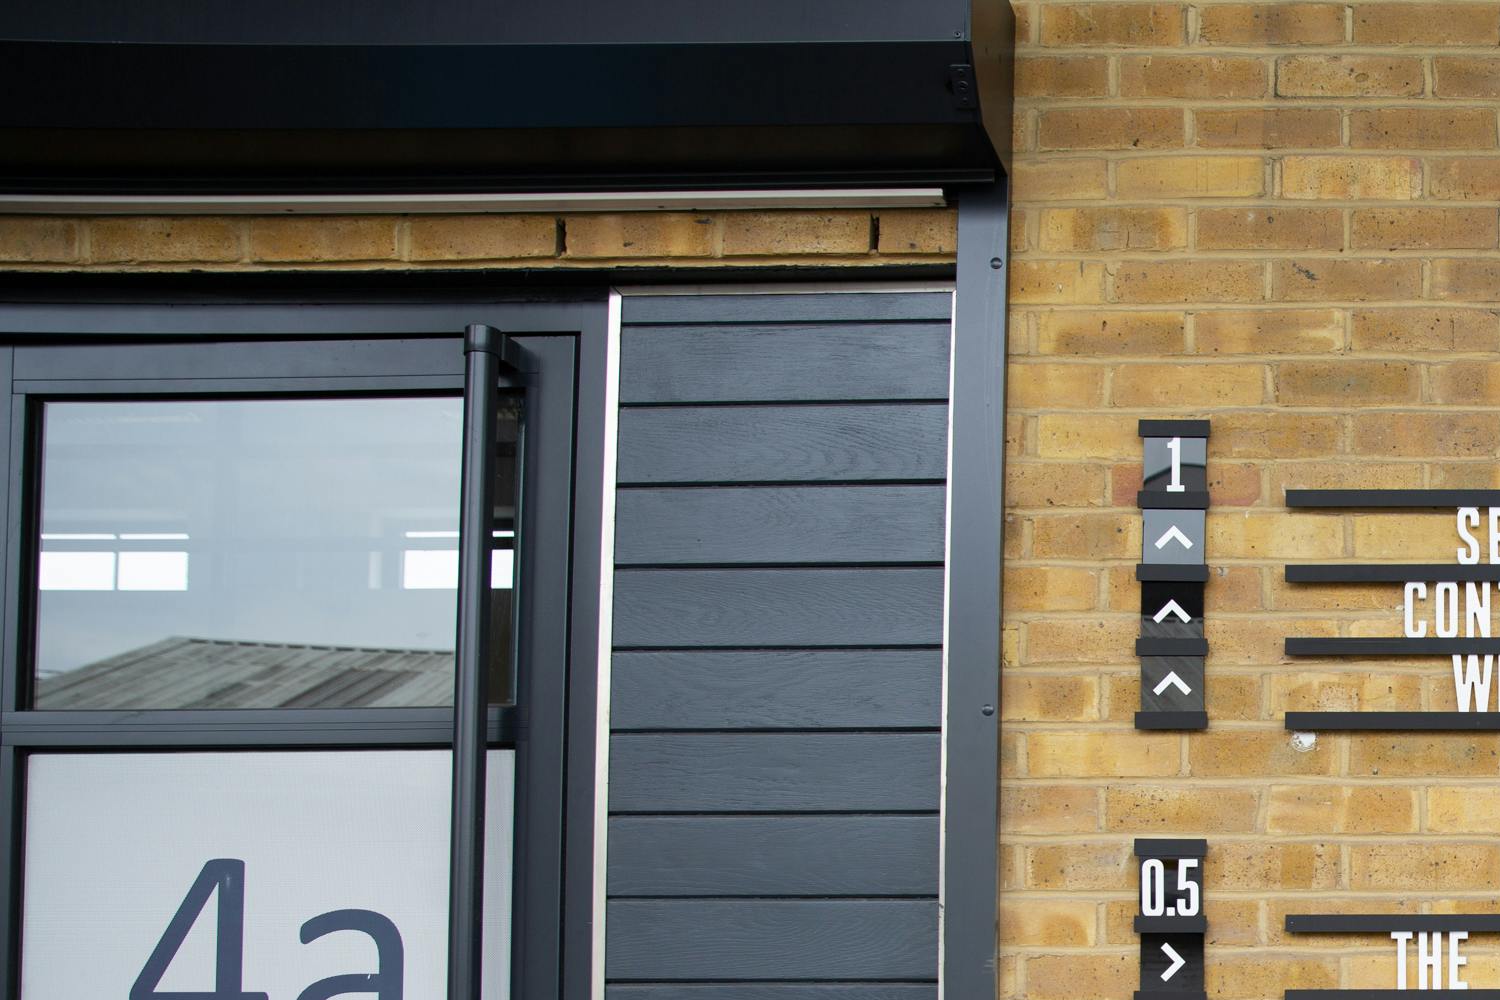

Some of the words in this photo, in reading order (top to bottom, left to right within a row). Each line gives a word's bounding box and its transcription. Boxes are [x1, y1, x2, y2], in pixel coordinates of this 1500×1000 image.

[1166, 437, 1185, 492] 1
[1141, 858, 1199, 917] 0.5
[1390, 931, 1469, 990] THE
